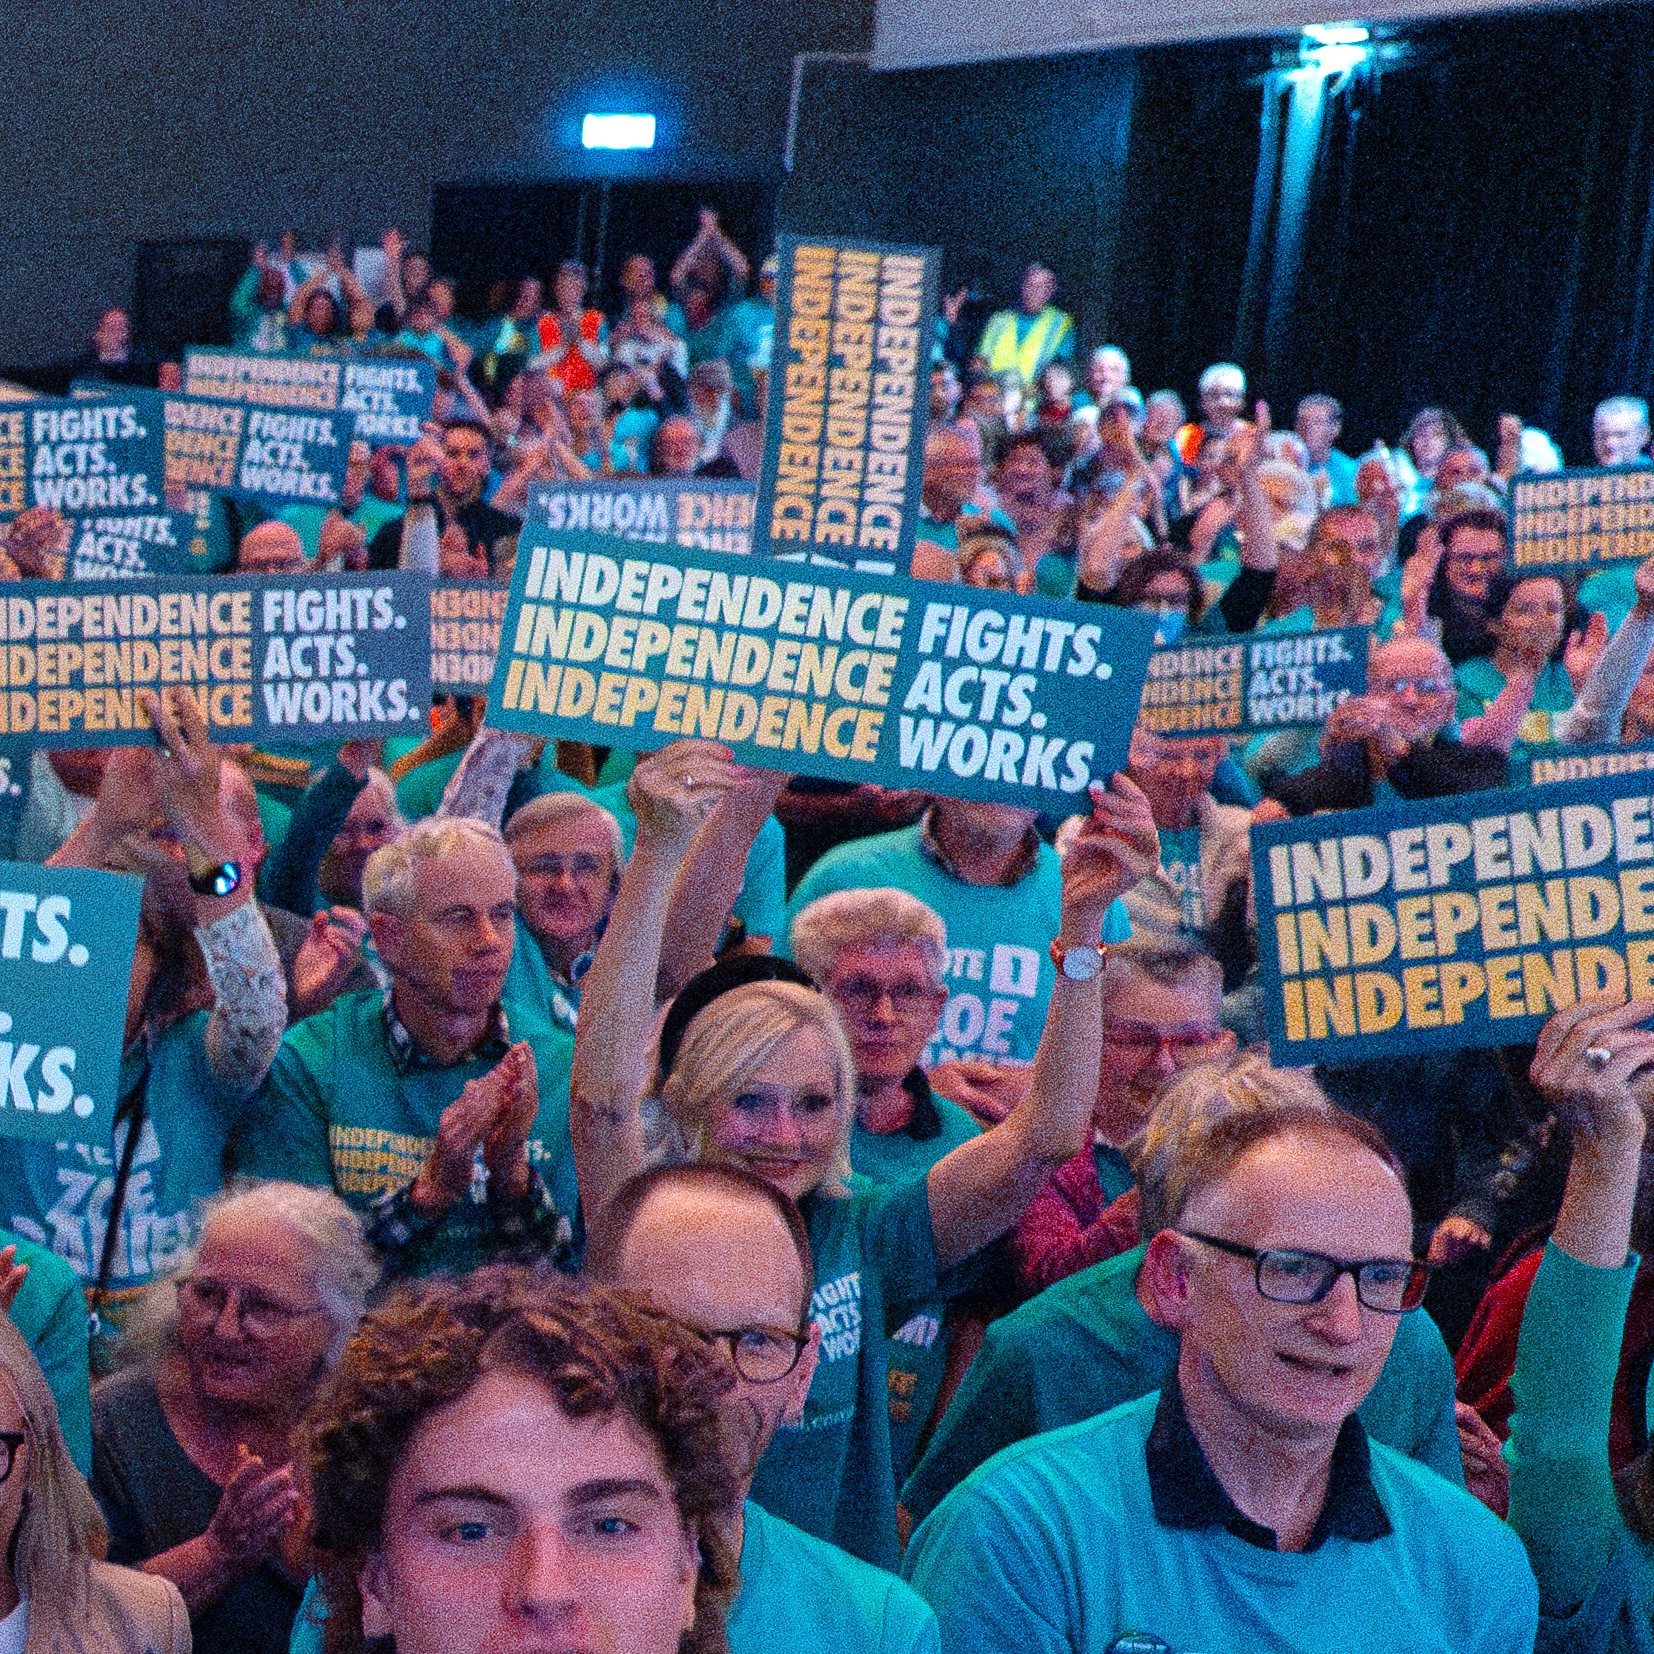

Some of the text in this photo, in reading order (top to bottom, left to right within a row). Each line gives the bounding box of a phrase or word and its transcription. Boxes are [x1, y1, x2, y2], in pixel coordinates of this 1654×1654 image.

[771, 246, 836, 541] INDEPENDENCE
[815, 250, 881, 546] INDEPENDENCE
[856, 256, 924, 551] INDEPENDENCE
[32, 406, 143, 442] FIGHTS.
[249, 412, 337, 446] FIGHTS.
[32, 442, 114, 476] ACTS.
[244, 438, 307, 468] ACTS.
[32, 474, 155, 510] WORKS.
[240, 467, 338, 499] WORKS.
[77, 537, 145, 568] ACTS.
[262, 589, 408, 634] FIGHTS.
[523, 547, 911, 649] INDEPENDENCE
[917, 600, 1119, 678] FIGHTS.
[261, 637, 368, 681] ACTS.
[512, 603, 899, 706] INDEPENDENCE
[904, 659, 1052, 728] ACTS.
[1250, 636, 1352, 666] FIGHTS.
[1249, 666, 1323, 694] ACTS.
[261, 682, 421, 727] WORKS.
[1249, 692, 1341, 724] WORK
[502, 659, 1115, 797] INDEPENDENCE WORKS.
[1269, 796, 1654, 906] INDEPENDE
[1276, 868, 1654, 973] INDEPENDE
[1283, 938, 1654, 1040] INDEPENDE
[929, 993, 1019, 1053] OE
